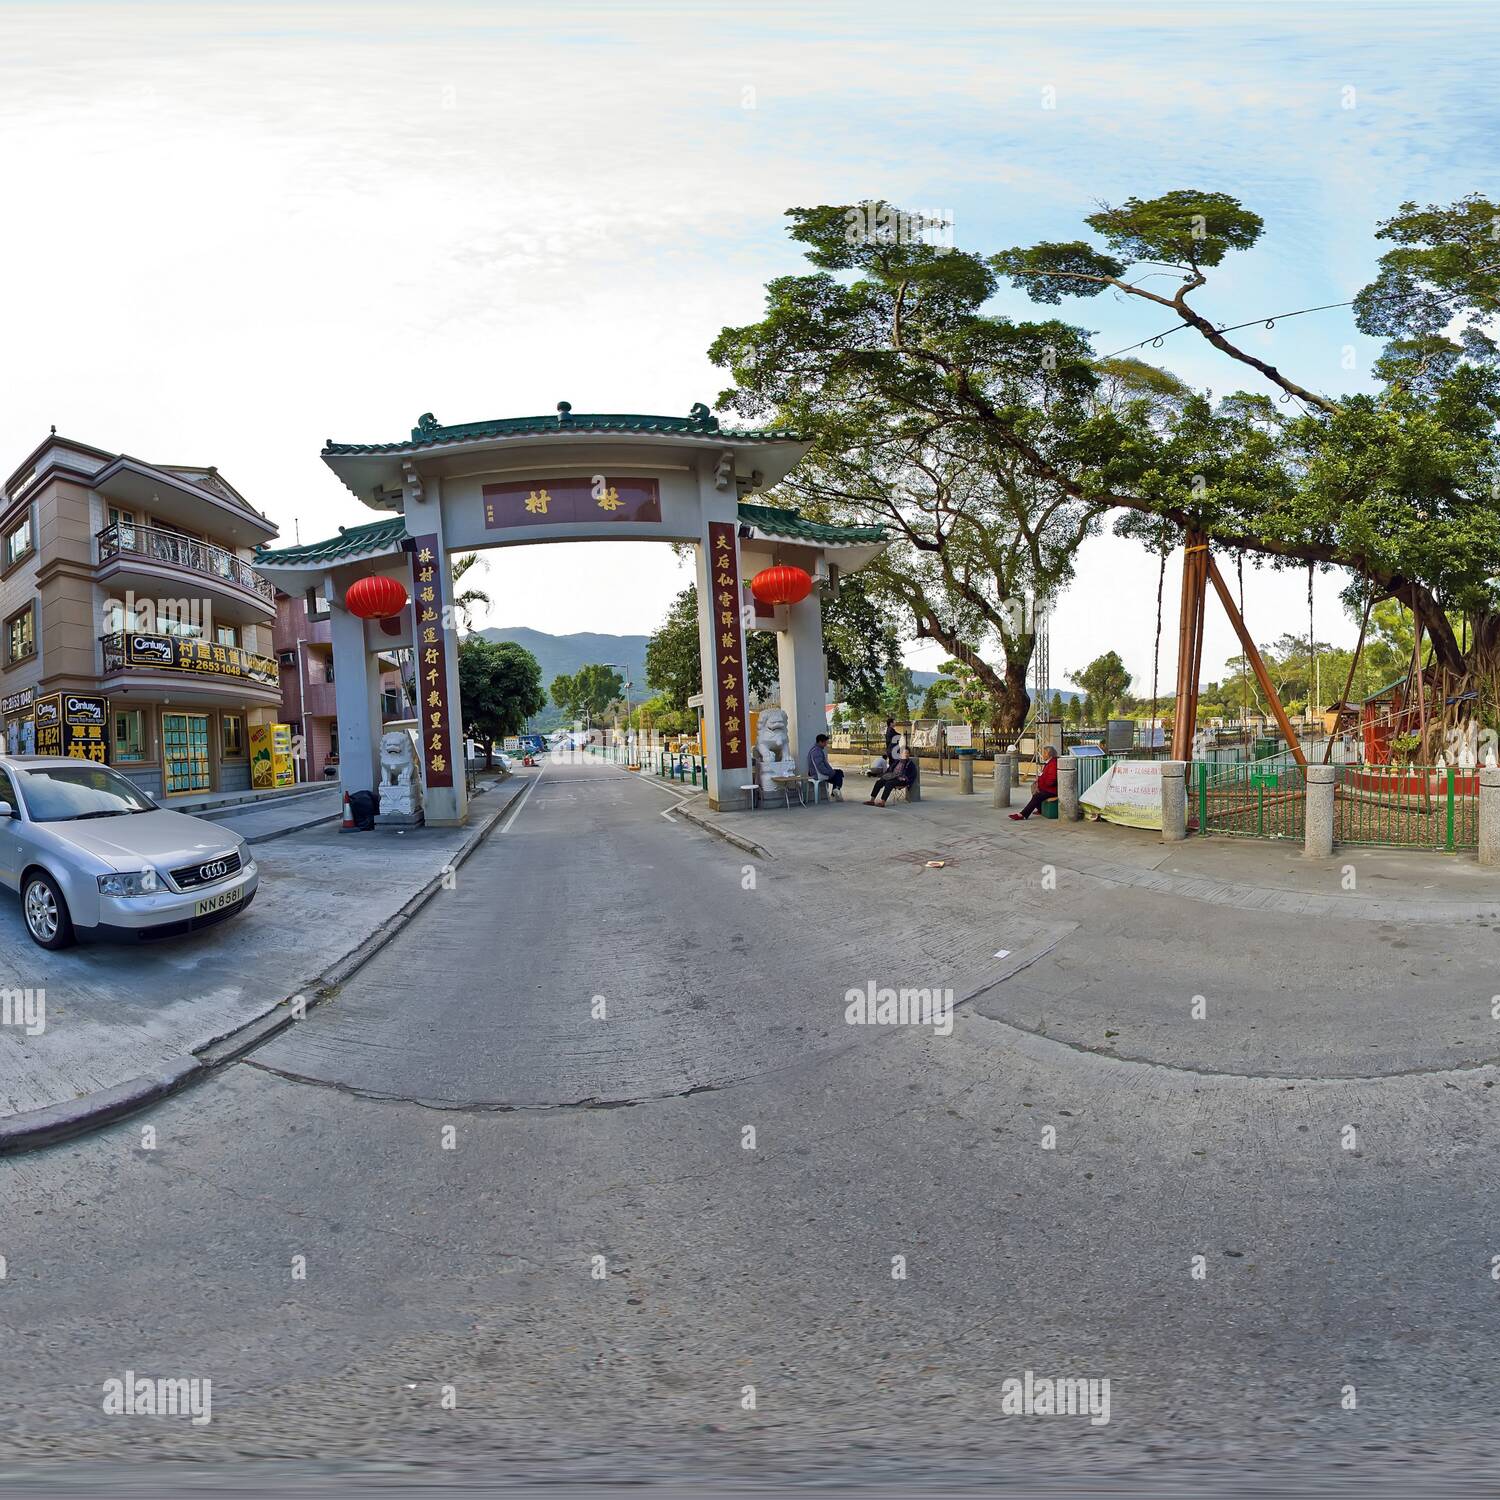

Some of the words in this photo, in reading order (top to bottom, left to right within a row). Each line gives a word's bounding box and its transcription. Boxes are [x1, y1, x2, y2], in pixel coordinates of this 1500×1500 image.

[178, 640, 240, 666] 村屋租售
[68, 698, 95, 711] Century
[68, 741, 106, 763] 林村
[199, 900, 216, 914] NN
